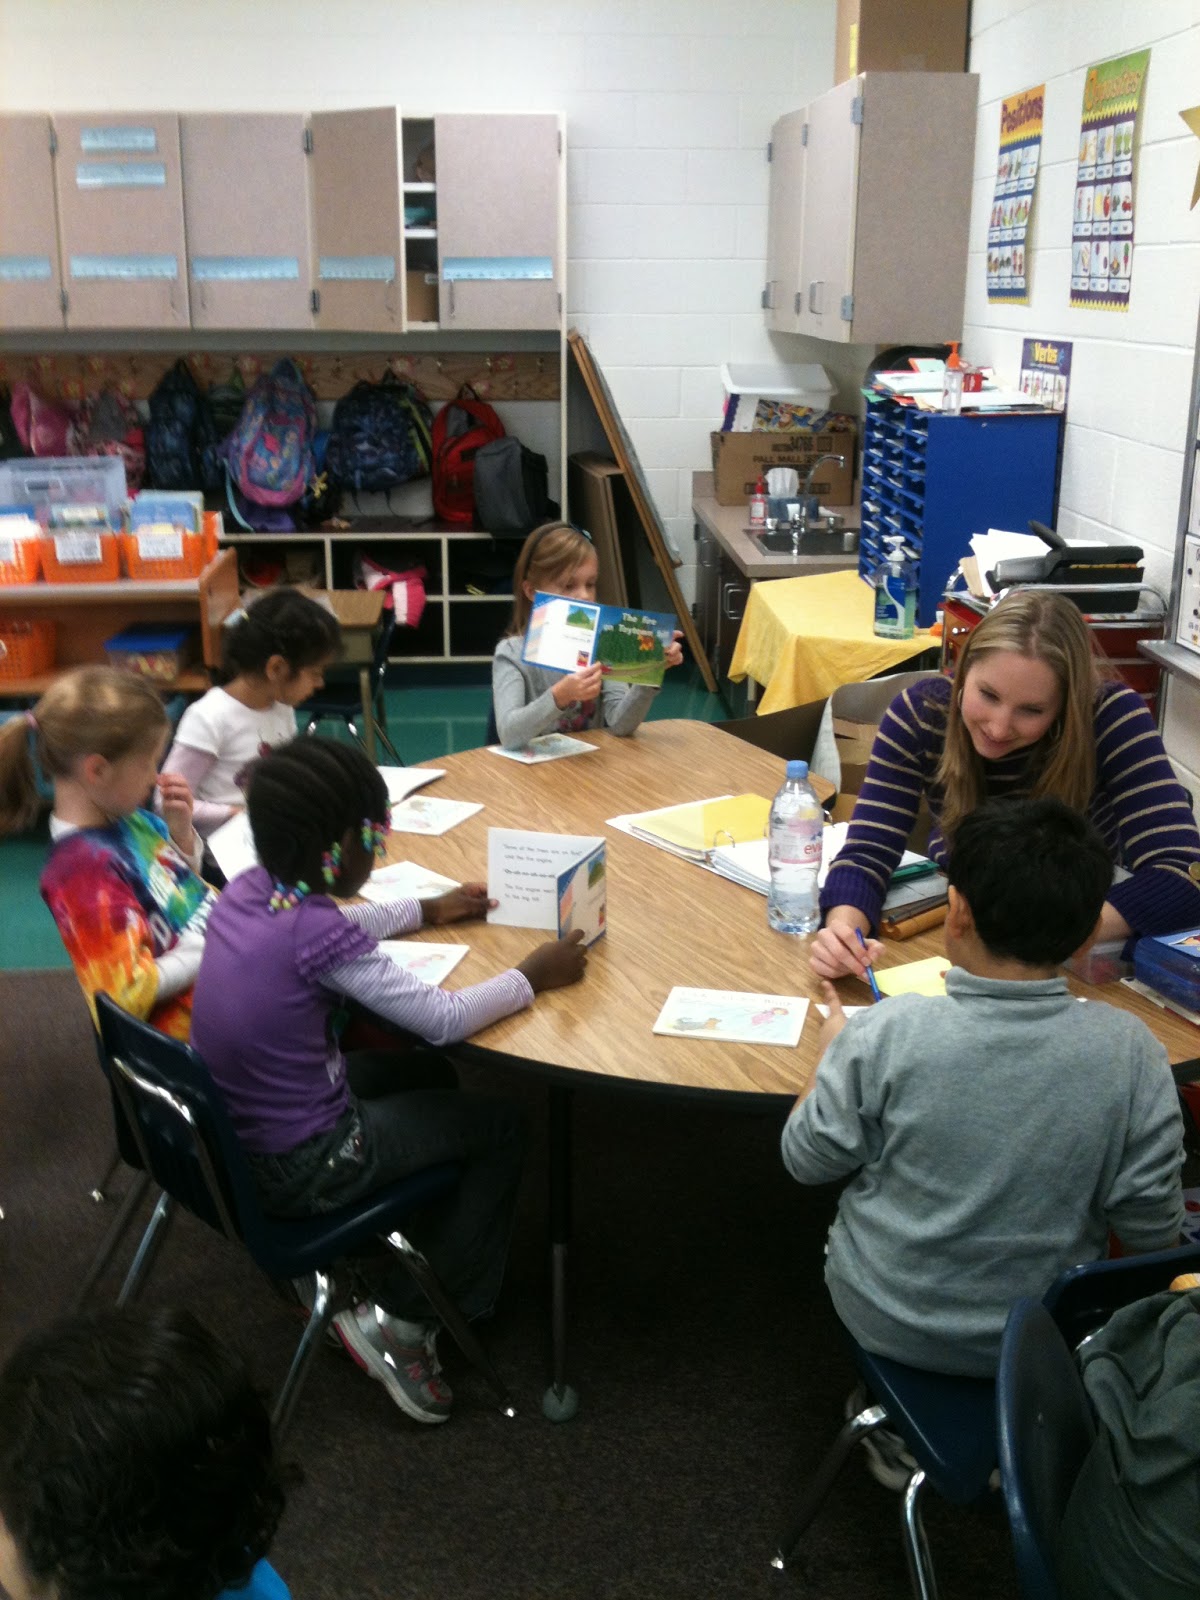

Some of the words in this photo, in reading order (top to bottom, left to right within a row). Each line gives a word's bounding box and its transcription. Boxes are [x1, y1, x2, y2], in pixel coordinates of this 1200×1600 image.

[1001, 95, 1043, 133] Positions
[1035, 342, 1058, 364] Verbs
[622, 612, 638, 623] The
